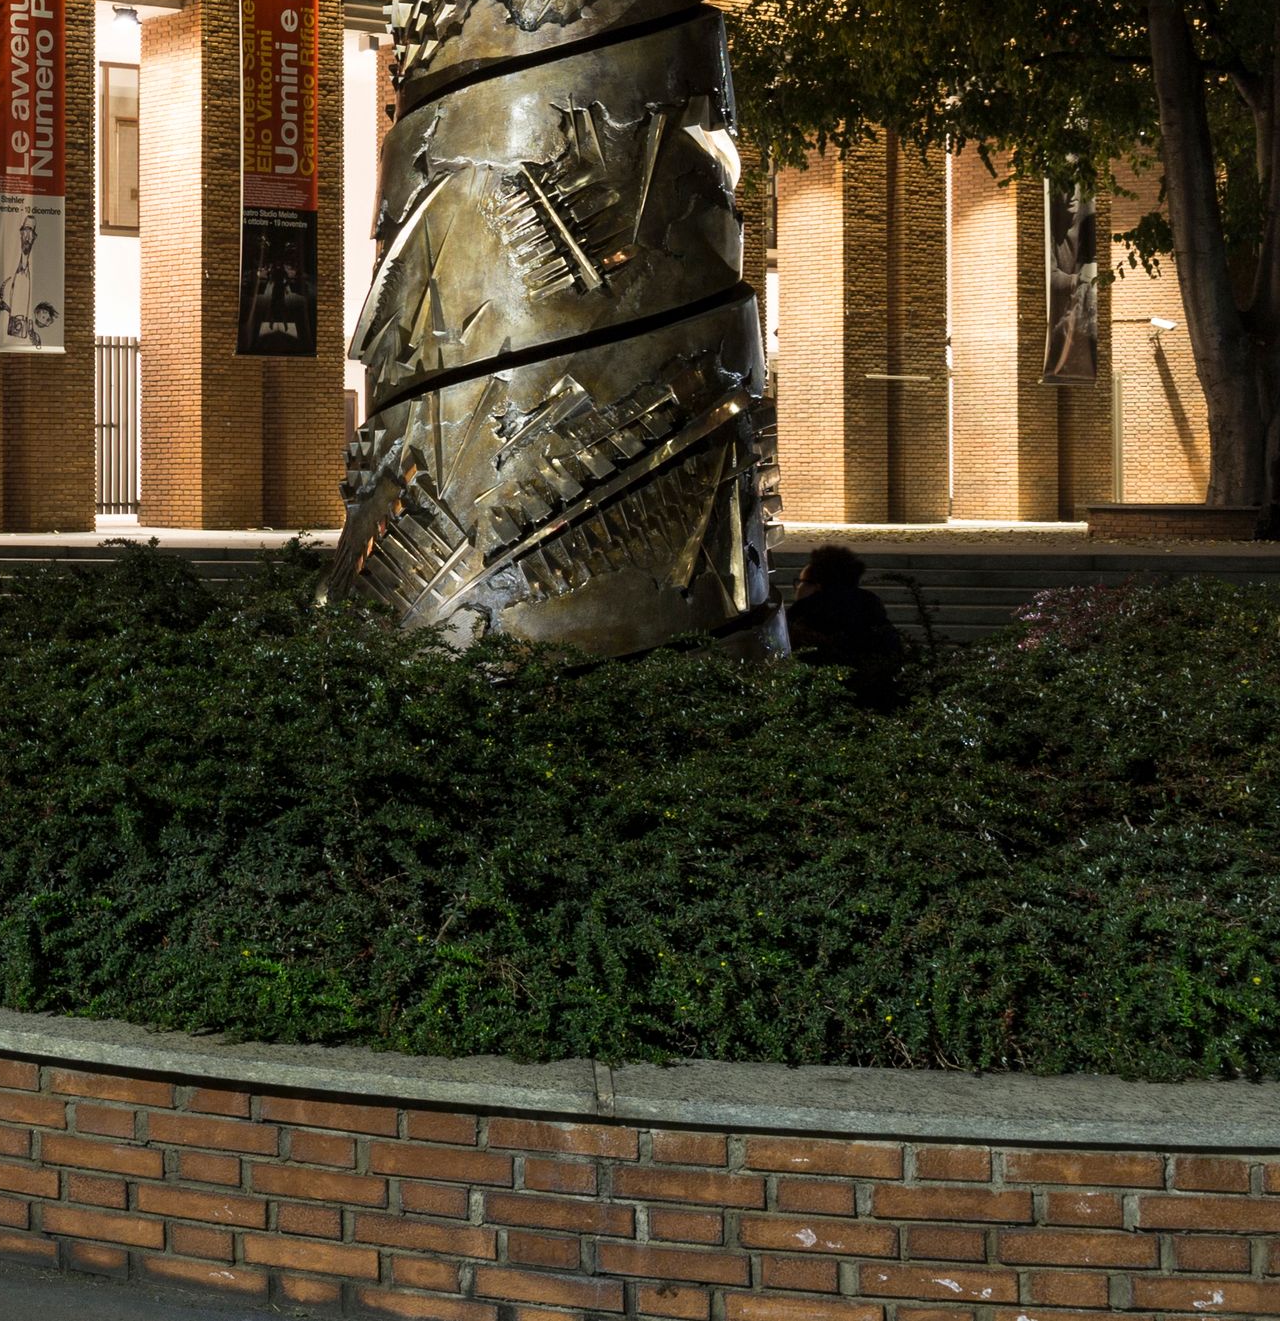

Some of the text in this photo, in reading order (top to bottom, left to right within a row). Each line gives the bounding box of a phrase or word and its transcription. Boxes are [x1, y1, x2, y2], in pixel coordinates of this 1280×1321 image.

[280, 8, 299, 33] e
[30, 29, 54, 177] Numero
[242, 78, 255, 173] Michele
[257, 30, 272, 174] Elio Vittorini
[275, 42, 298, 174] Uomini
[300, 7, 315, 176] Carmelo Rifici
[6, 130, 30, 175] Le
[32, 207, 61, 215] dicembre
